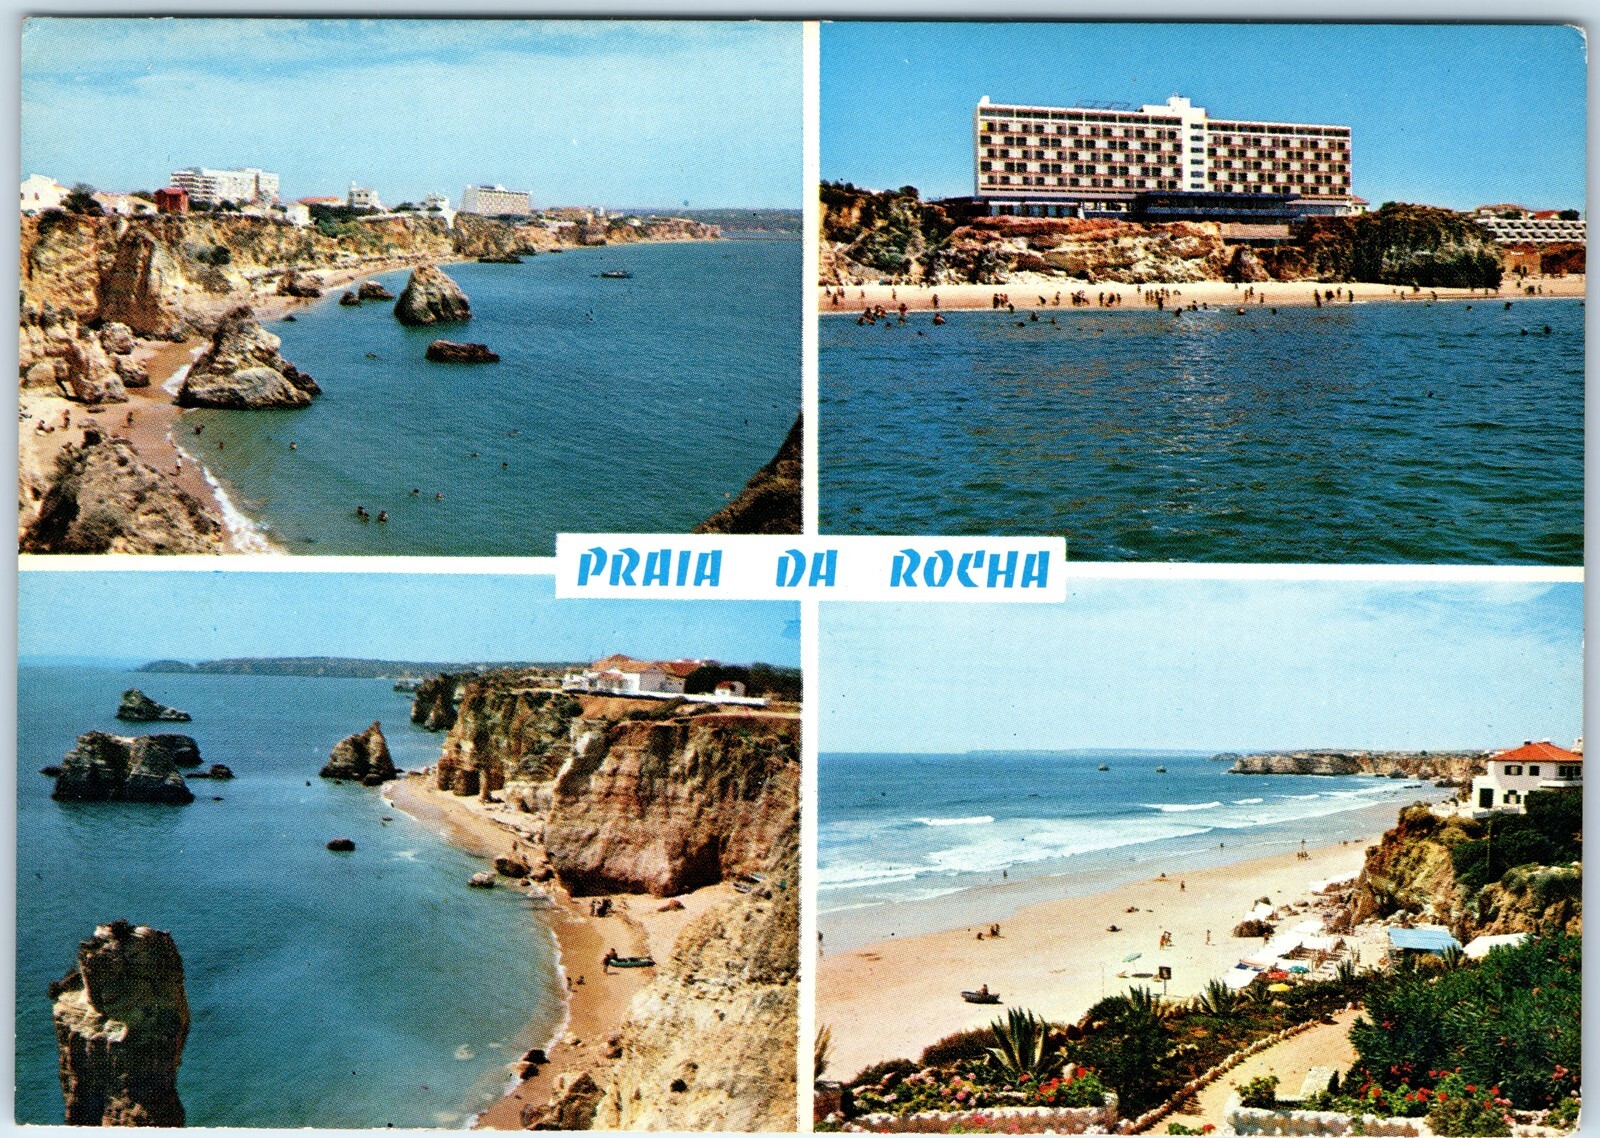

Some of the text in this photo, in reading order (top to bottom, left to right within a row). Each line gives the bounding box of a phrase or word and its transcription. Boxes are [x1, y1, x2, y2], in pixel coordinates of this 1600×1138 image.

[577, 547, 1050, 588] PRAIA DA ROCHA
